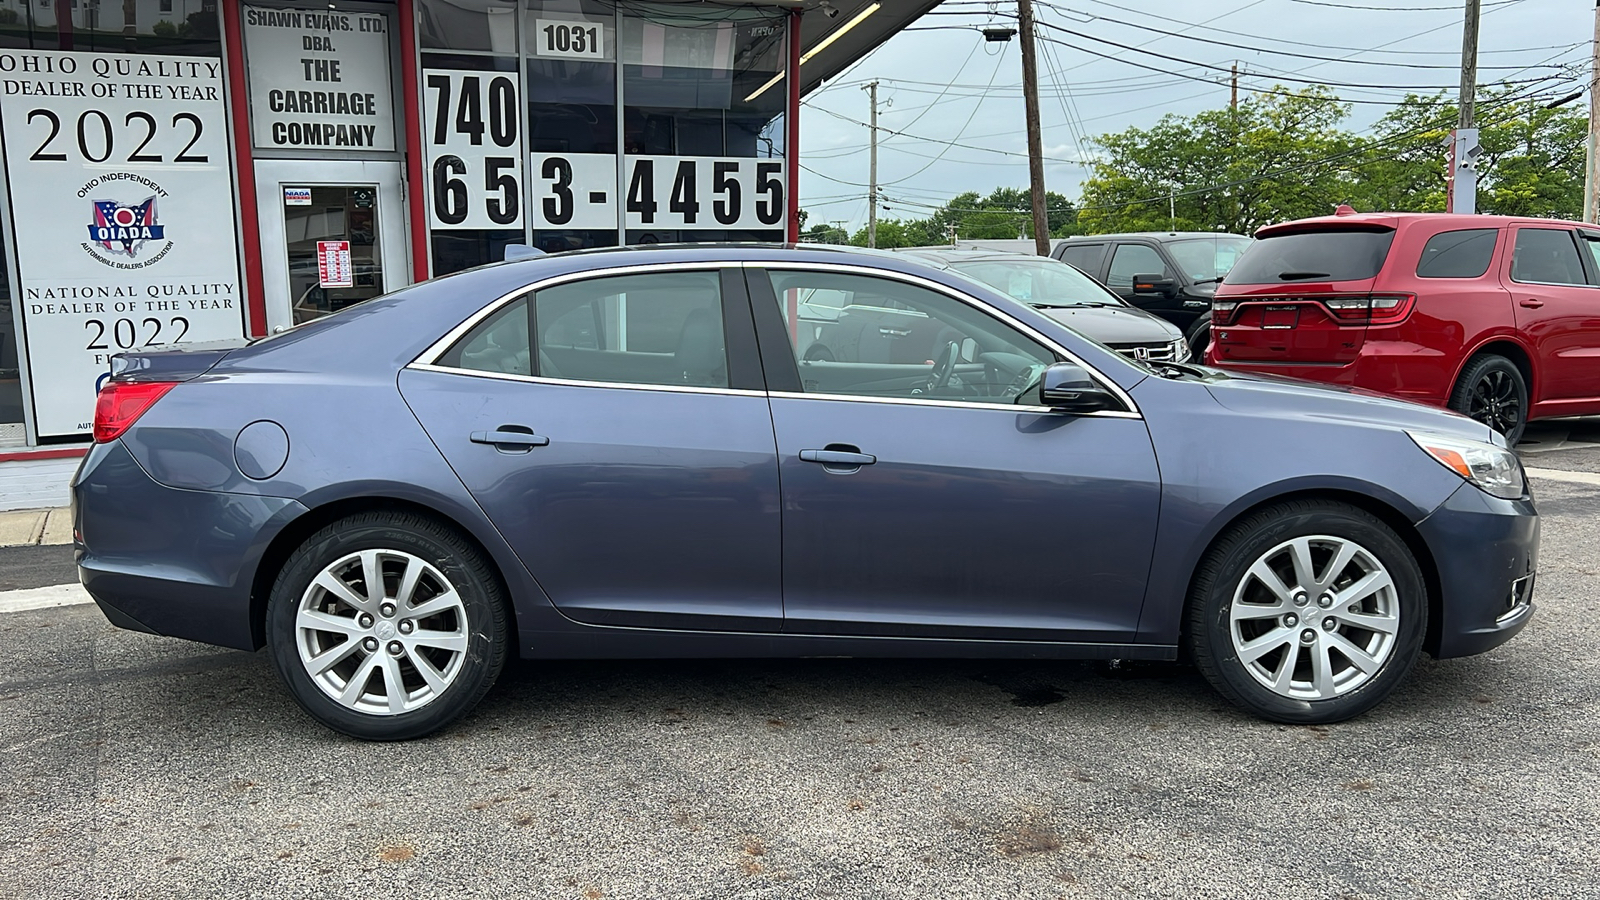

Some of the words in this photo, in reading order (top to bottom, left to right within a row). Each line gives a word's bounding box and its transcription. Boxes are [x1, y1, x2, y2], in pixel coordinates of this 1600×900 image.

[247, 10, 302, 28] SHAWN
[304, 14, 354, 32] EVANS.
[359, 17, 386, 34] LTD.
[302, 35, 336, 52] DBA.
[543, 24, 598, 54] 1031
[0, 54, 77, 74] OHIO
[92, 58, 219, 79] QUALITY
[300, 58, 341, 82] THE
[3, 79, 86, 97] DEALER
[91, 82, 117, 98] OF
[122, 84, 163, 99] THE
[167, 85, 218, 101] YEAR
[268, 89, 376, 115] CARRIAGE
[427, 74, 518, 148] 740
[27, 108, 210, 163] 2022
[272, 121, 376, 147] COMPANY
[77, 178, 99, 199] OHIO
[99, 172, 169, 199] INDEPENDENT
[98, 226, 153, 240] OIADA
[80, 241, 116, 268] AUTOMOBILE
[116, 262, 144, 270] DEALERS
[144, 240, 174, 268] ASSOCIATION
[27, 286, 138, 300] NATIONAL
[147, 283, 234, 299] QUALITY
[31, 302, 106, 315] DEALER
[114, 301, 137, 313] OF
[145, 300, 180, 311] THE
[188, 299, 233, 310] YEAR
[85, 316, 193, 350] 2022
